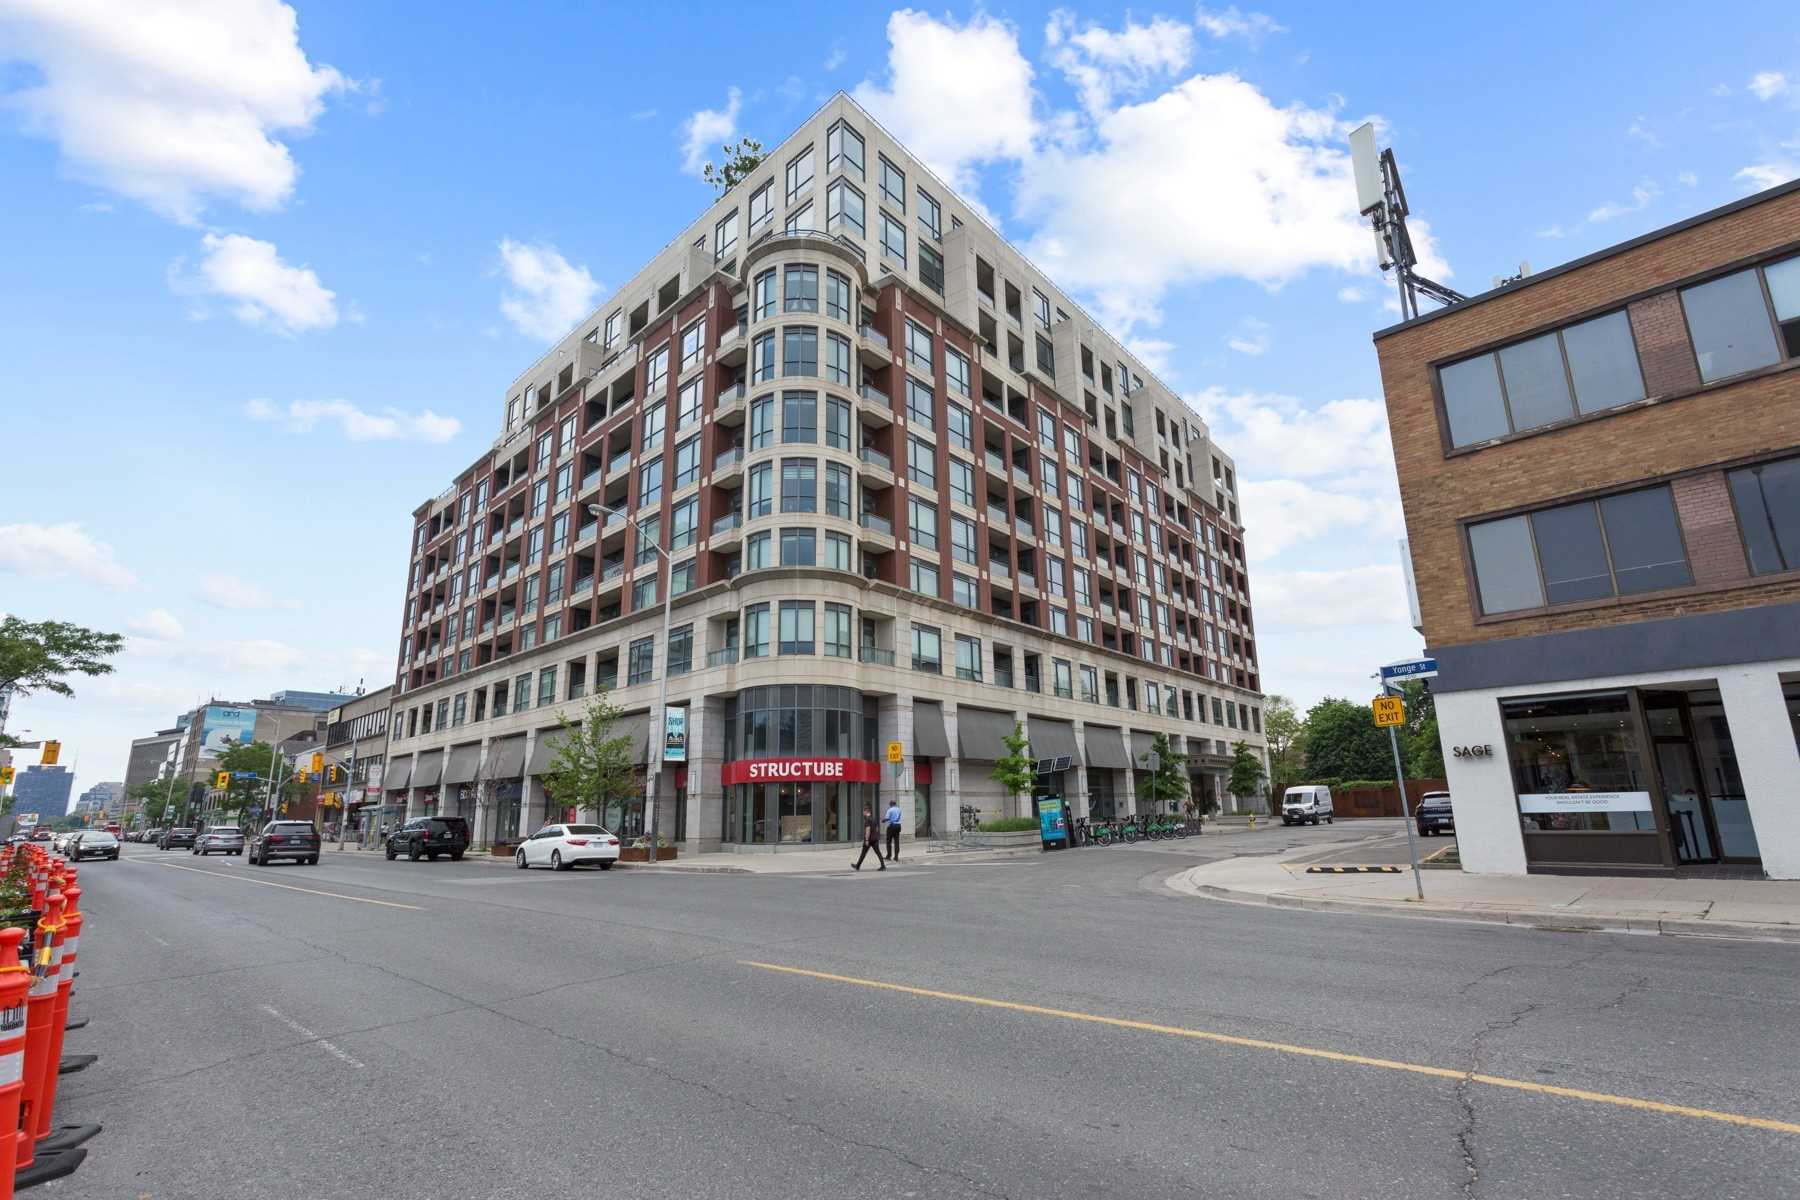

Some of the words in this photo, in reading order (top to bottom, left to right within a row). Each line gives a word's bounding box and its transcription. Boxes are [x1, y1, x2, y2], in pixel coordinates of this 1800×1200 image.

[1392, 664, 1416, 674] Yonge
[1419, 663, 1426, 671] St
[1380, 701, 1394, 710] NO
[1378, 712, 1399, 722] EXIT
[1453, 744, 1494, 758] SAGE
[749, 761, 844, 778] STRUCTUBE
